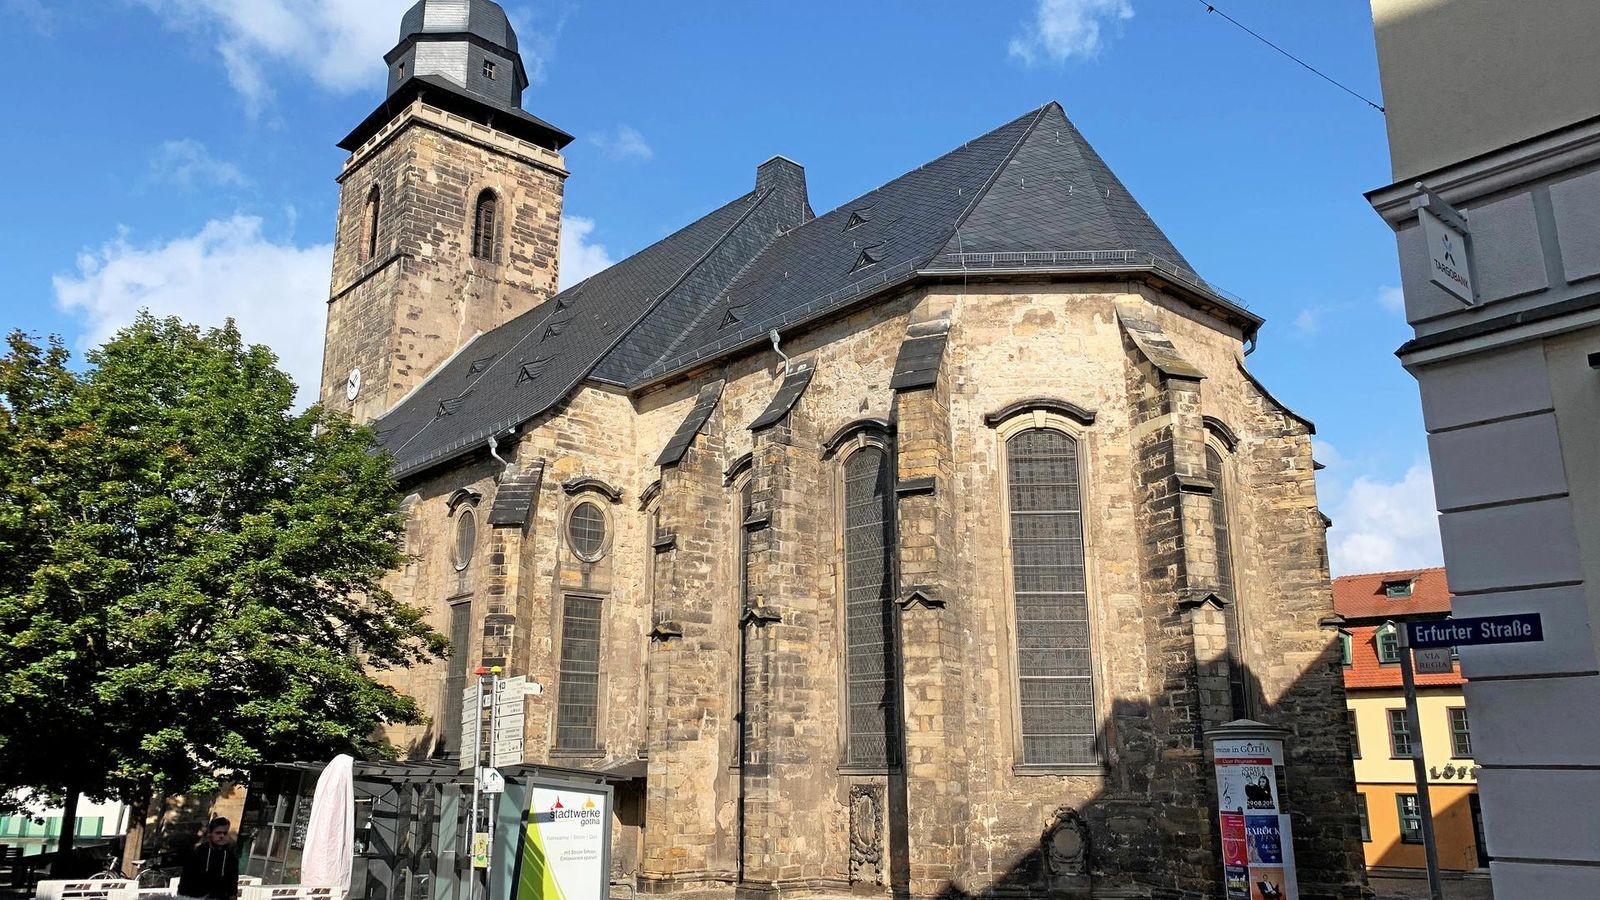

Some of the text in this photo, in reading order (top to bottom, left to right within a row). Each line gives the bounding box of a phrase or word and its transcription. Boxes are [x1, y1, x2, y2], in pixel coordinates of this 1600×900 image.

[1434, 258, 1469, 290] TARGOBANK
[1415, 619, 1532, 642] Erfurter Straße
[1424, 652, 1440, 660] VIA
[1419, 662, 1448, 670] REGIA
[1240, 744, 1271, 753] GOTHA
[549, 808, 601, 819] stadtwerke
[580, 818, 601, 827] gotha
[1245, 826, 1281, 835] BAROCK
